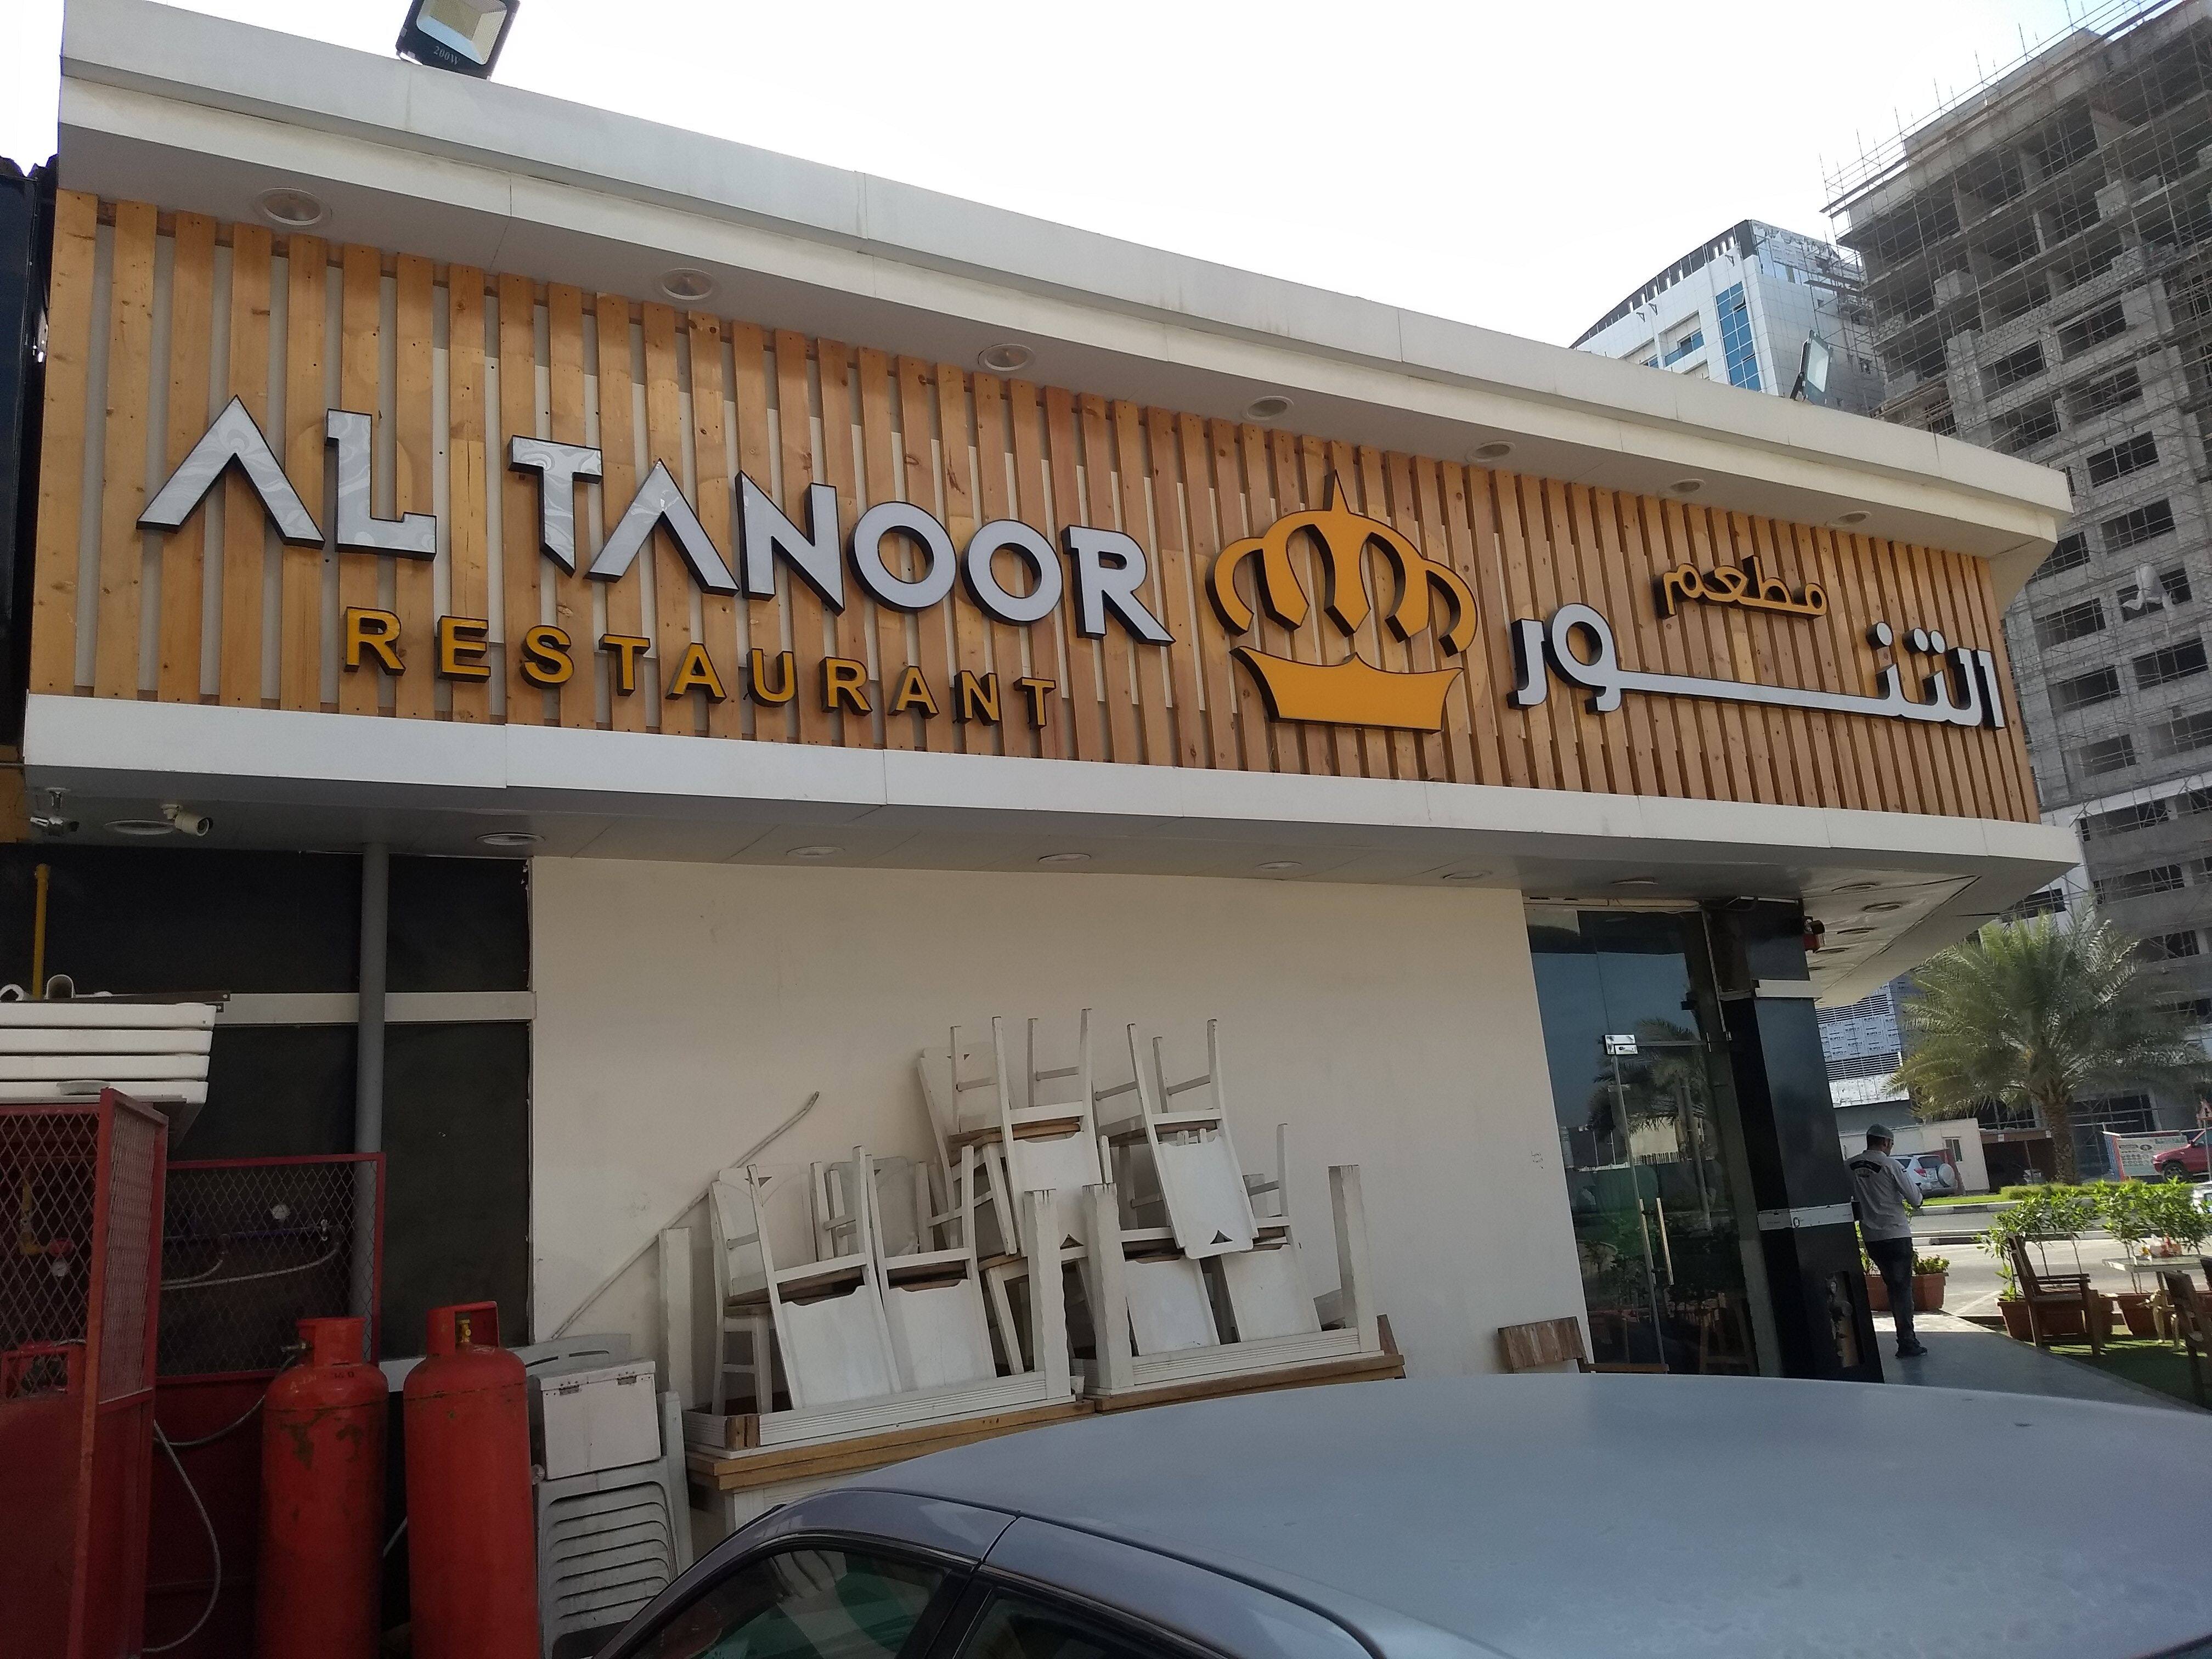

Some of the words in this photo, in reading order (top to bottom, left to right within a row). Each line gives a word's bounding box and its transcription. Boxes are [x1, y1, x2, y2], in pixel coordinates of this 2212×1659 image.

[433, 46, 460, 66] 200W
[137, 394, 436, 561] AL
[508, 435, 1176, 646] TANOOR
[1654, 555, 1828, 619] مطعم
[343, 606, 1056, 730] RESTAURANT
[1507, 603, 2005, 730] التنور
